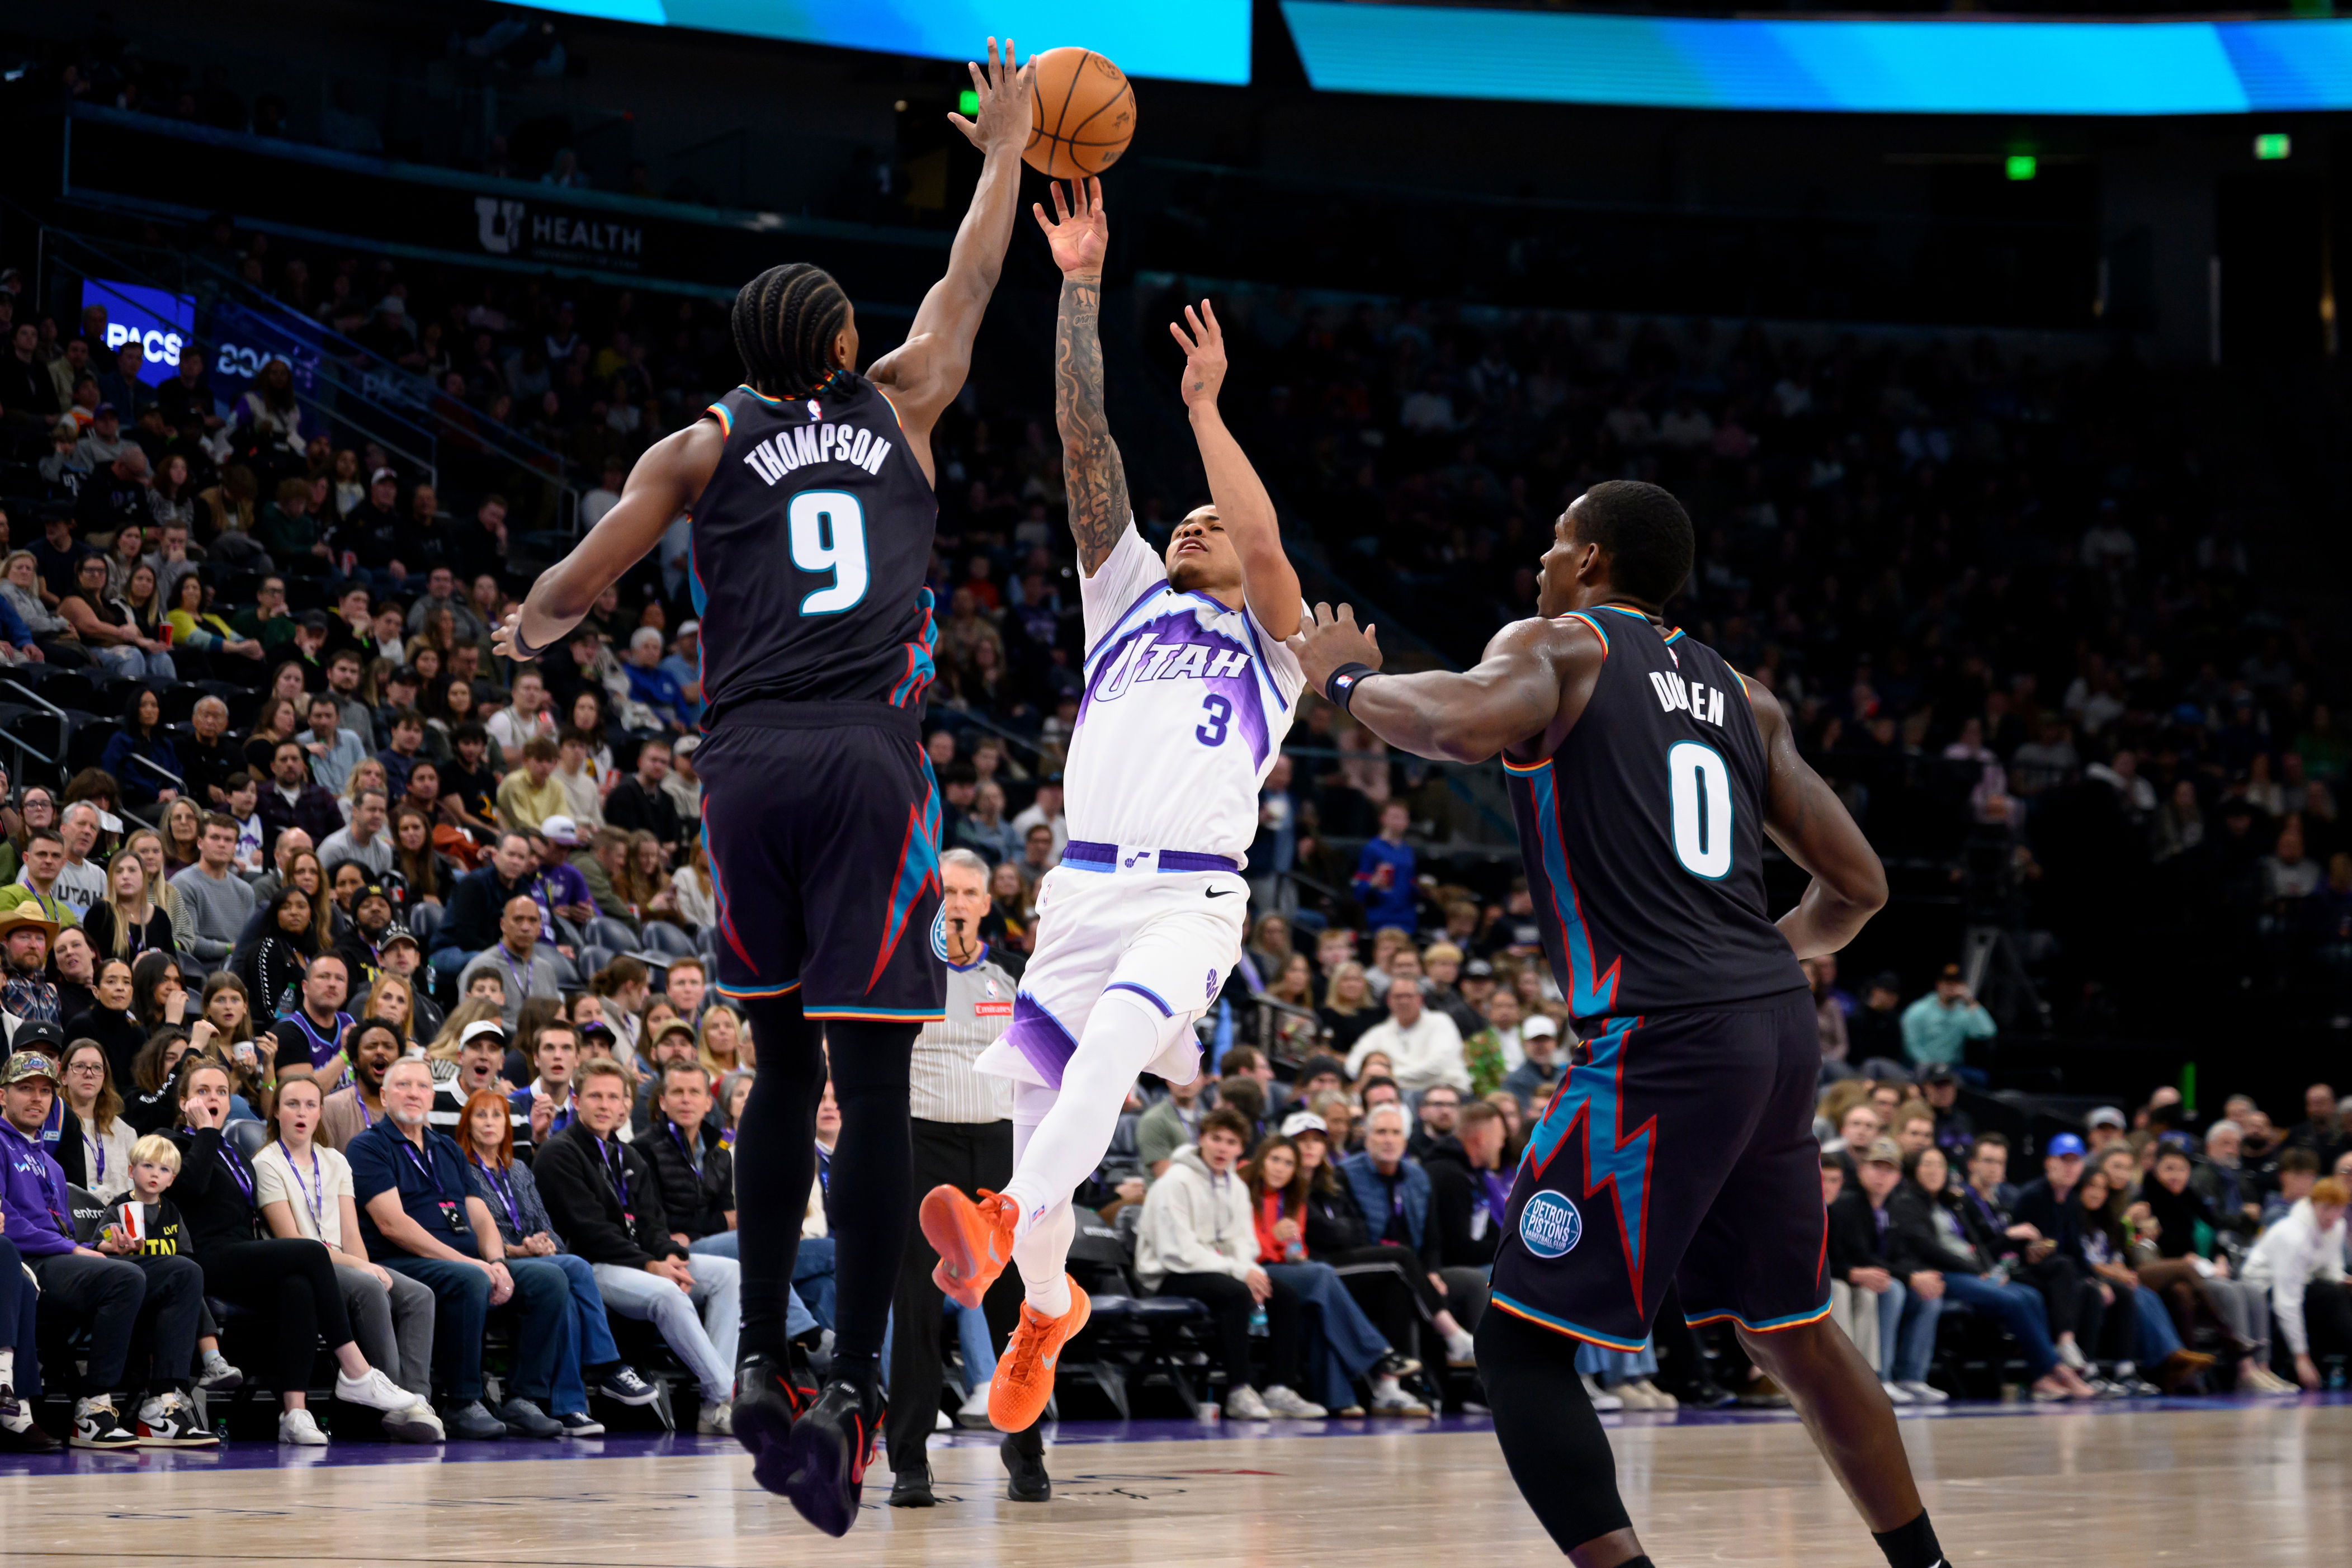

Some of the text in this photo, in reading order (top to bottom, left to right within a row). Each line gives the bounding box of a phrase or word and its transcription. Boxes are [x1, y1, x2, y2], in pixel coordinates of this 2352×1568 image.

[475, 196, 643, 254] U HEALTH
[743, 423, 892, 486] THOMPSON
[787, 489, 870, 617] 9
[1094, 632, 1253, 702] UTAH
[1195, 693, 1232, 747] 3
[1667, 739, 1734, 881] 0
[975, 1005, 1011, 1014] Emirates
[163, 1224, 178, 1235] LVT
[1525, 1229, 1553, 1245] BASKETBALL
[1553, 1239, 1566, 1249] CLUB
[1527, 1214, 1570, 1243] PISTONS
[1532, 1198, 1574, 1227] DETROIT
